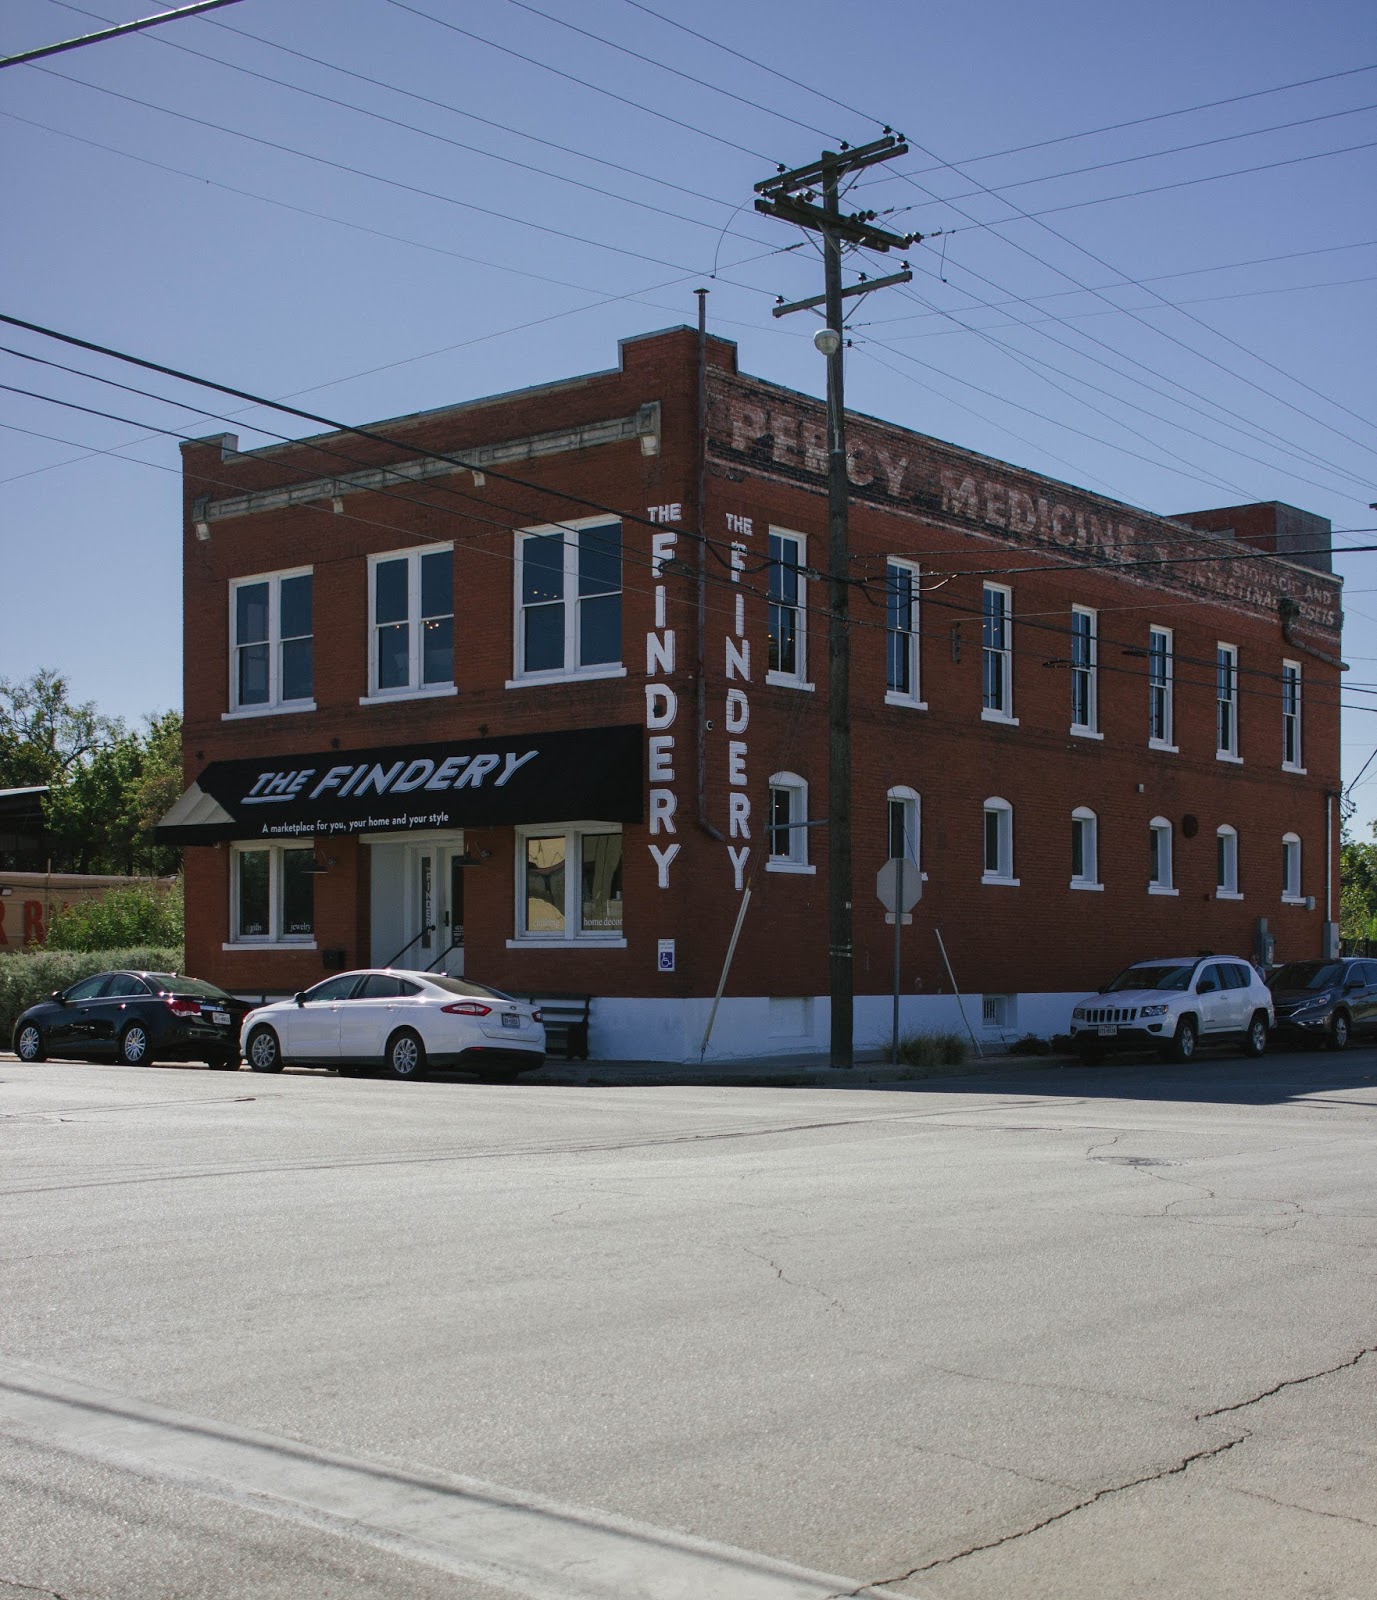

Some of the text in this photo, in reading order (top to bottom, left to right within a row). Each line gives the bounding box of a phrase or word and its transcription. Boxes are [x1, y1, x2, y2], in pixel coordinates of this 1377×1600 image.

[647, 502, 682, 523] THE
[726, 512, 753, 537] THE
[1305, 585, 1332, 606] AND
[645, 531, 682, 889] FINDERY
[725, 541, 753, 891] FINDERY
[248, 750, 539, 800] THE FINDERY
[261, 811, 449, 835] A marketplace for you, your home and your style
[289, 921, 312, 932] jewelry
[583, 916, 622, 927] home decor
